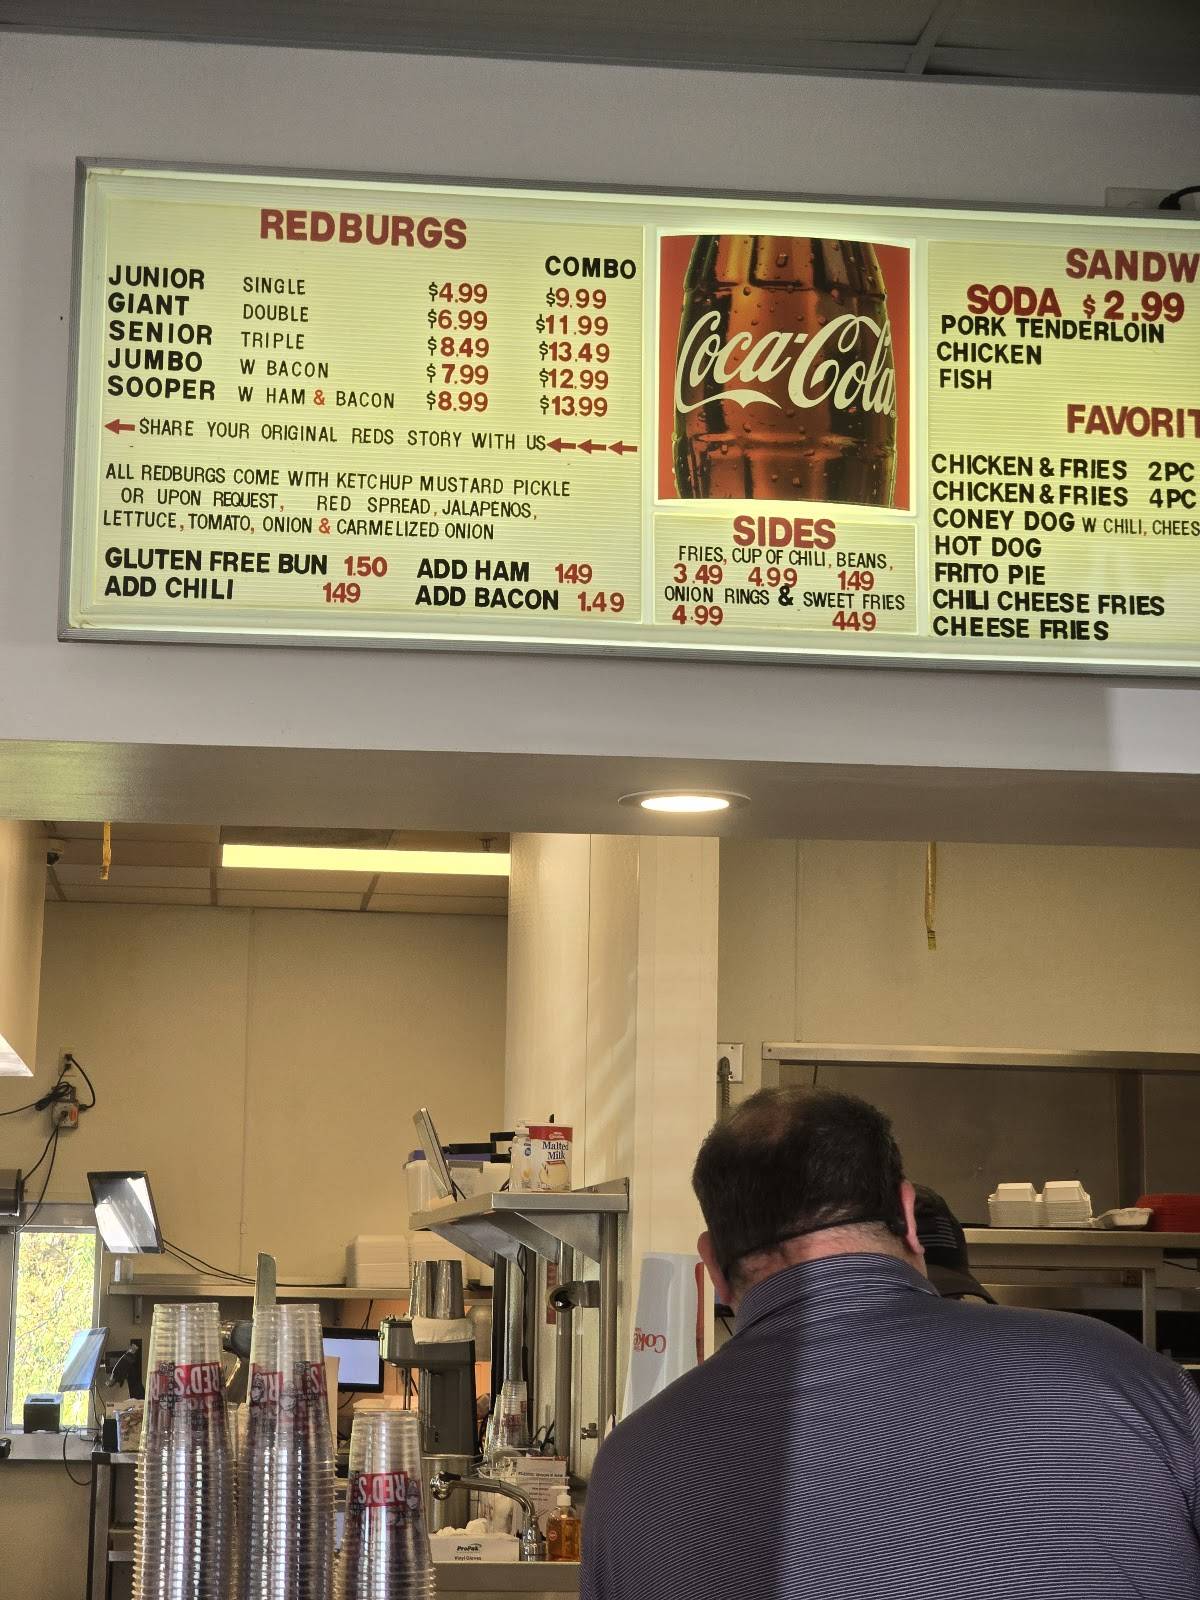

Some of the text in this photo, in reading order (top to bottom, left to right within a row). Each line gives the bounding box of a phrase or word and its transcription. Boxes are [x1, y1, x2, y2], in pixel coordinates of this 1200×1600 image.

[260, 208, 467, 250] REDBURGS
[545, 255, 637, 279] COMBO
[1065, 248, 1200, 283] SANDW
[108, 265, 607, 309] JUNIOR SINGLE $4.99 $9.99
[108, 292, 609, 336] GIANT DOUBLE $6.99 $11.99
[967, 284, 1185, 323] SODA $2.99
[109, 319, 610, 364] SENIOR TRIPLE $8.49 $13.49
[941, 314, 1164, 344] PORK TENDERLOIN
[108, 348, 609, 390] JUMBO W BACON $7.99 $12.99
[675, 310, 896, 415] Coca-Cola
[936, 343, 1042, 366] CHICKEN
[939, 368, 992, 390] FISH
[107, 375, 608, 418] SOOPER W HAM & BACON $8.99 $13.99
[139, 417, 546, 451] SHARE YOUR ORIGINAL REDS STORY WITH US
[1066, 403, 1200, 438] FAVORIT
[105, 463, 571, 497] ALL REDBURGS COME WITH KETCHUP MUSTARD PICKLE
[932, 453, 1033, 477] CHICKEN
[1039, 457, 1055, 478] &
[1060, 458, 1128, 481] FRIES
[121, 487, 144, 504] OR
[157, 489, 201, 507] UPON
[213, 490, 285, 512] REQUEST,
[316, 495, 351, 512] RED
[933, 480, 1034, 504] CHICKEN
[1039, 484, 1054, 505] &
[1059, 484, 1129, 507] FRIES
[103, 510, 494, 540] LETTUCE, TOMATO, ONION & CARMELIZED ONION
[733, 515, 836, 550] SIDES
[933, 507, 1014, 531] CONEY
[1024, 510, 1075, 532] DOG
[1082, 517, 1097, 533] W
[104, 547, 202, 571] GLUTEN
[209, 551, 271, 574] FREE
[278, 554, 328, 575] BUN
[732, 548, 763, 565] CUP
[765, 549, 783, 565] OF
[935, 535, 1042, 558] HOT DOG
[417, 558, 468, 580] ADD
[475, 560, 530, 582] HAM
[747, 566, 798, 588] 4.99
[934, 562, 1045, 586] FRITO PIE
[104, 575, 157, 598] ADD
[165, 576, 234, 600] CHILI
[415, 585, 625, 613] ADD BACON 1.49
[664, 582, 906, 611] ONION RINGS & SWEET FRIES
[933, 588, 1165, 617] CHILI CHEESE FRIES
[933, 615, 1109, 641] CHEESE FRIES
[547, 1151, 566, 1160] Milk
[358, 1474, 406, 1504] RED'S
